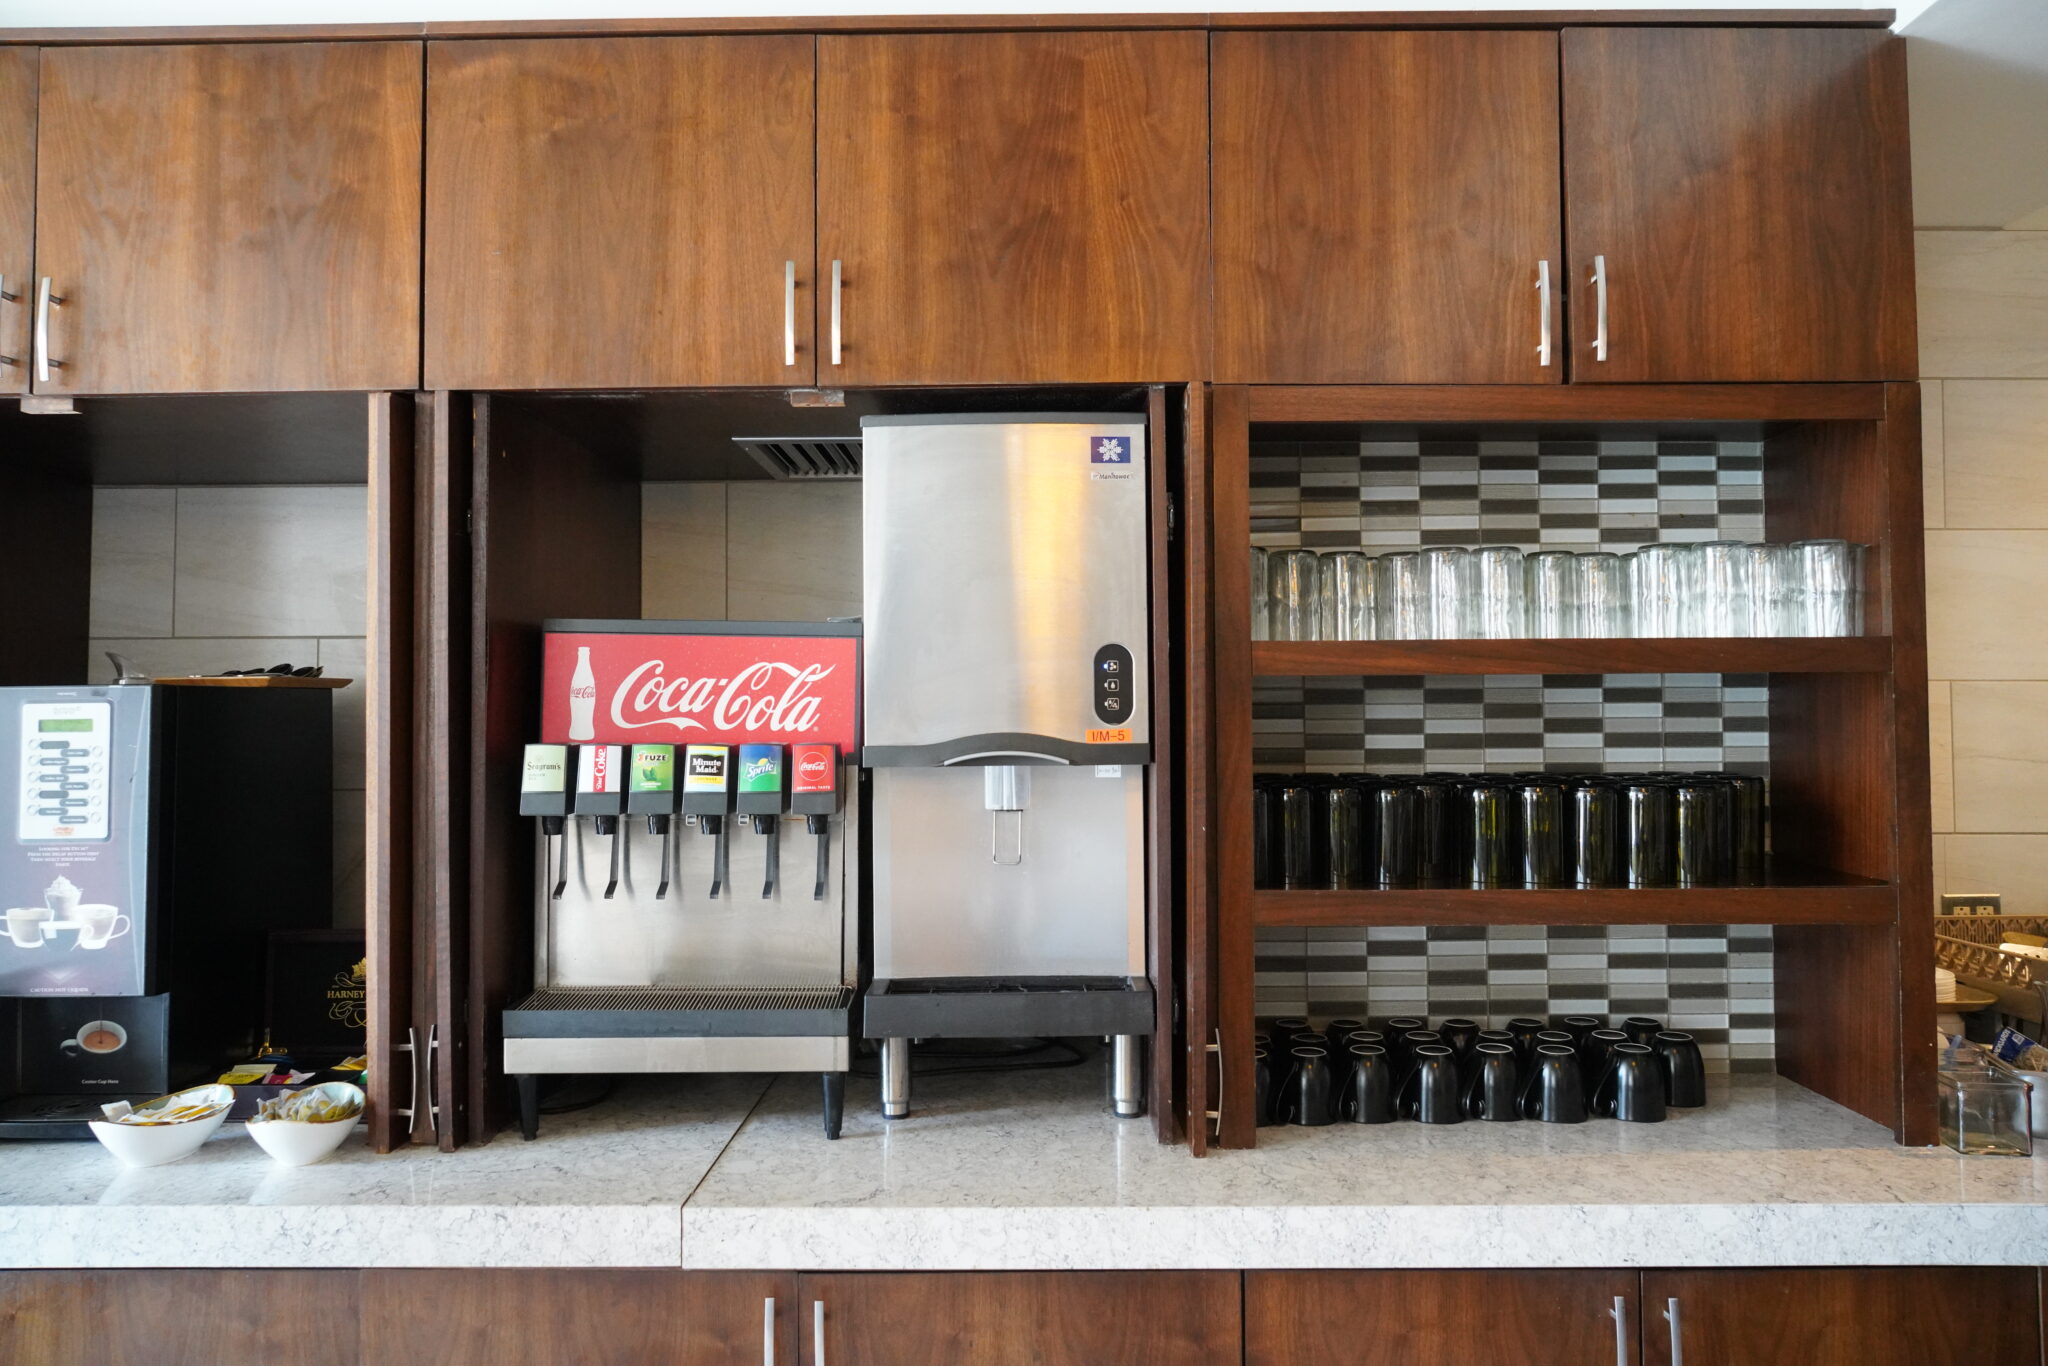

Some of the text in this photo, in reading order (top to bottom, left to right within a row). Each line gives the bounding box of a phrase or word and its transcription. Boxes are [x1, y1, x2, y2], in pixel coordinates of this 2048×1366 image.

[610, 659, 837, 732] Coca-Cola
[1092, 730, 1125, 741] I/M-5
[527, 761, 561, 771] Seagram's
[595, 748, 607, 776] Coke
[692, 757, 722, 767] Minute
[696, 765, 717, 773] Maid
[746, 762, 775, 777] Sprite
[327, 990, 366, 999] HARNEY
